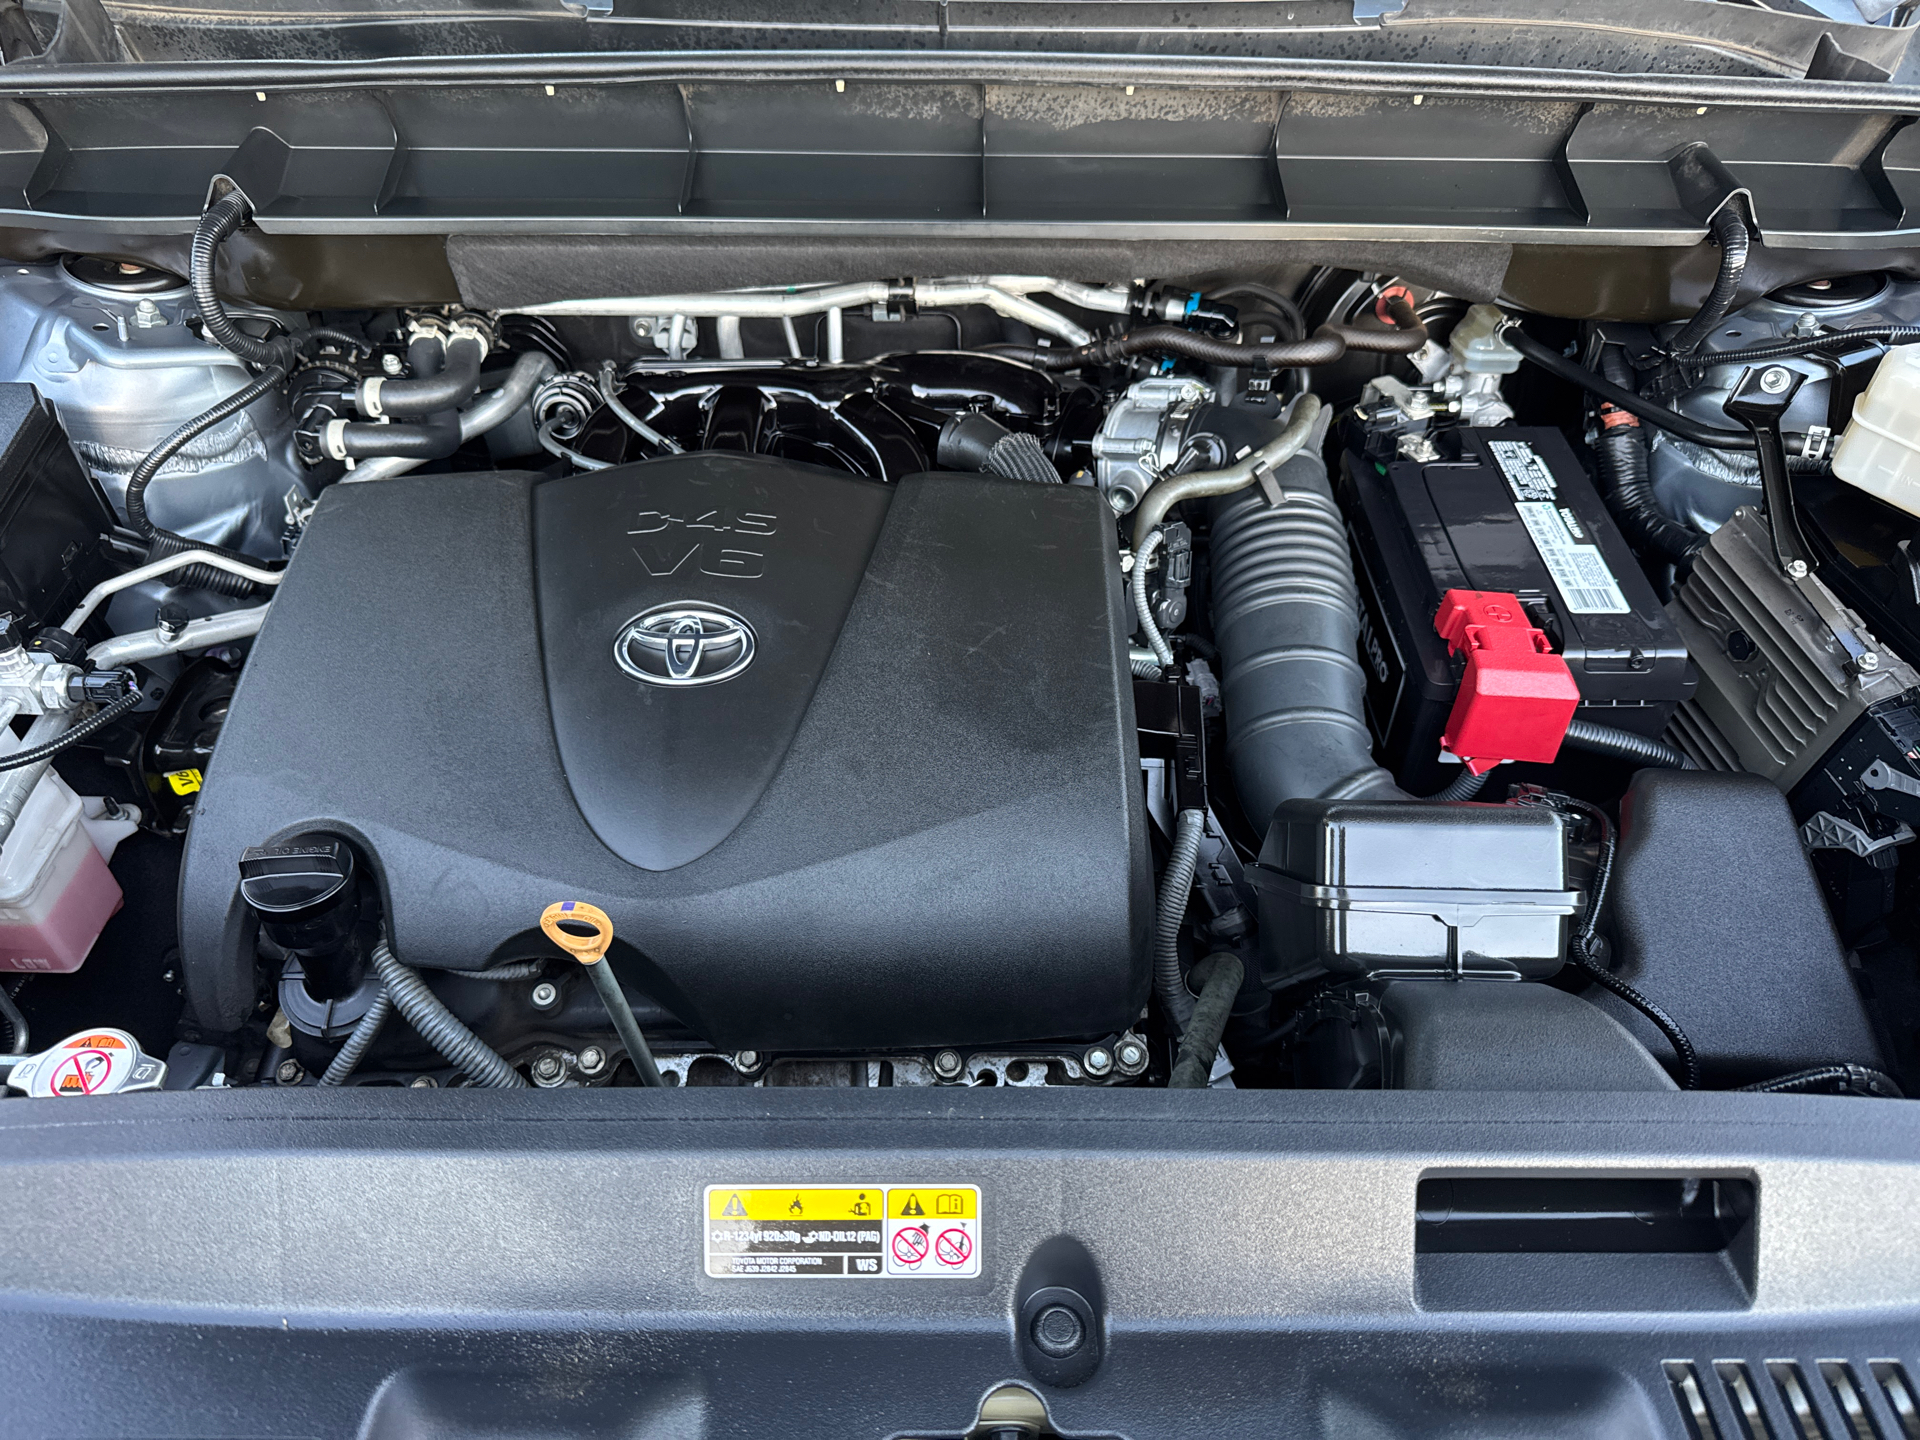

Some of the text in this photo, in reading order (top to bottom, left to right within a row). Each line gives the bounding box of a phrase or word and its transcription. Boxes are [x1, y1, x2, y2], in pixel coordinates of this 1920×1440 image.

[627, 510, 777, 536] D-4S
[632, 543, 764, 579] V6
[274, 847, 290, 855] OIL
[857, 1231, 880, 1244] (PAG)
[732, 1257, 822, 1265] TOYOTA MOTOR CORPORATION
[855, 1258, 878, 1272] WS
